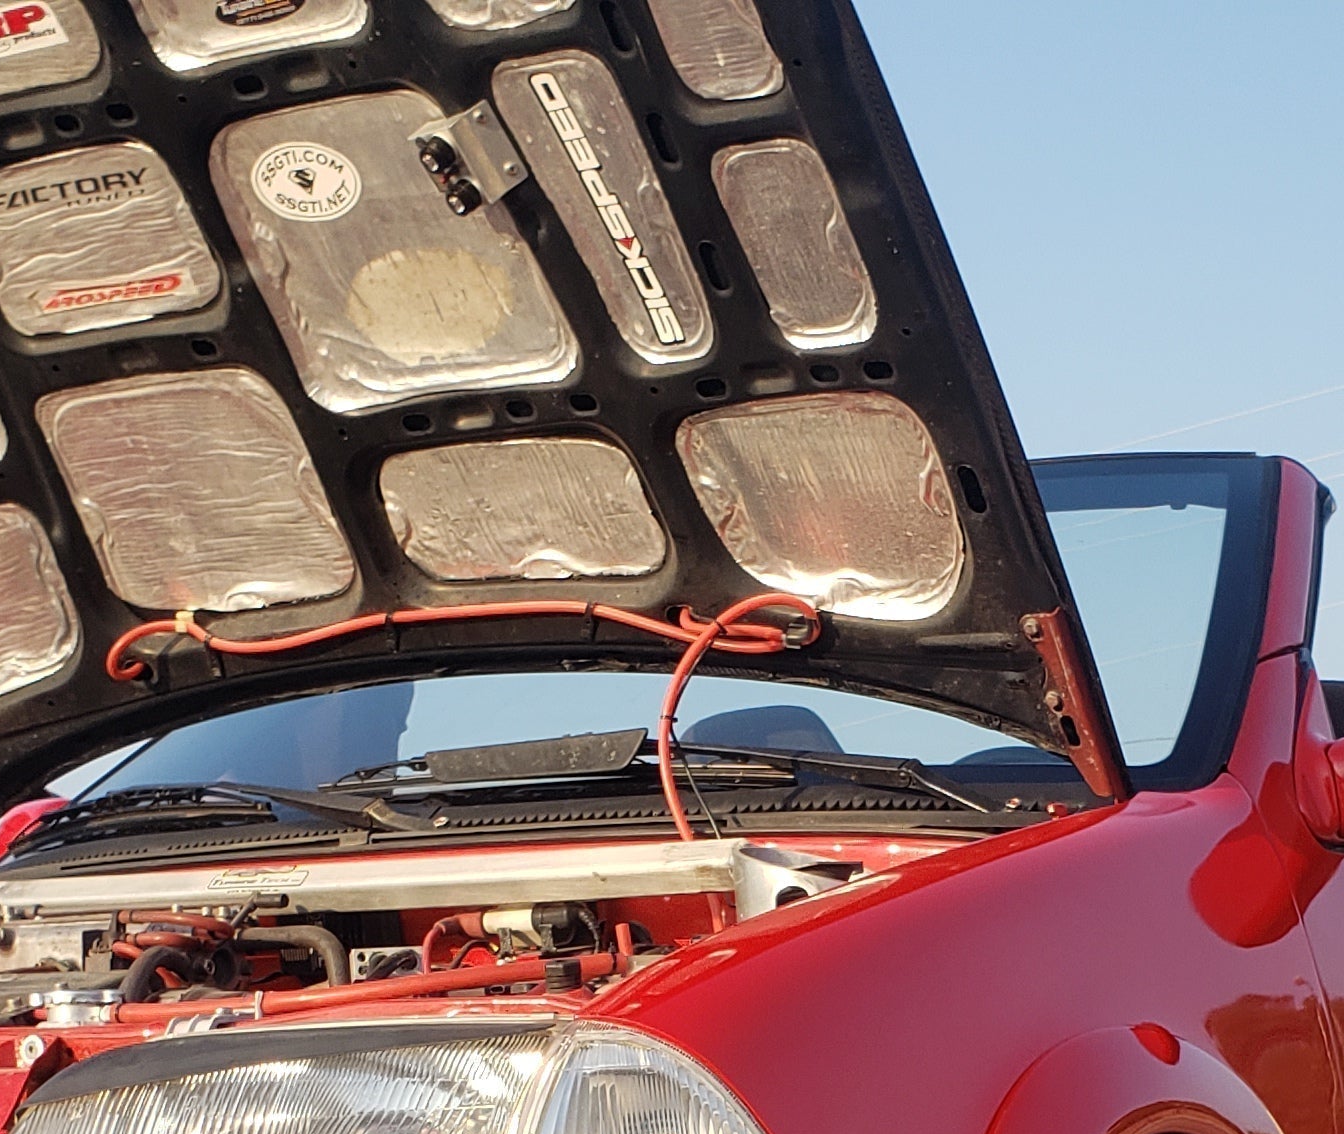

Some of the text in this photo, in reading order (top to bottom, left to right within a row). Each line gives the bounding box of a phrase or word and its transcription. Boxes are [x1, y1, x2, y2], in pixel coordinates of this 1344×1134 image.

[261, 150, 344, 187] SSGTI.COM
[276, 179, 351, 213] SSGTI.NET
[529, 72, 686, 344] SICKSPEED
